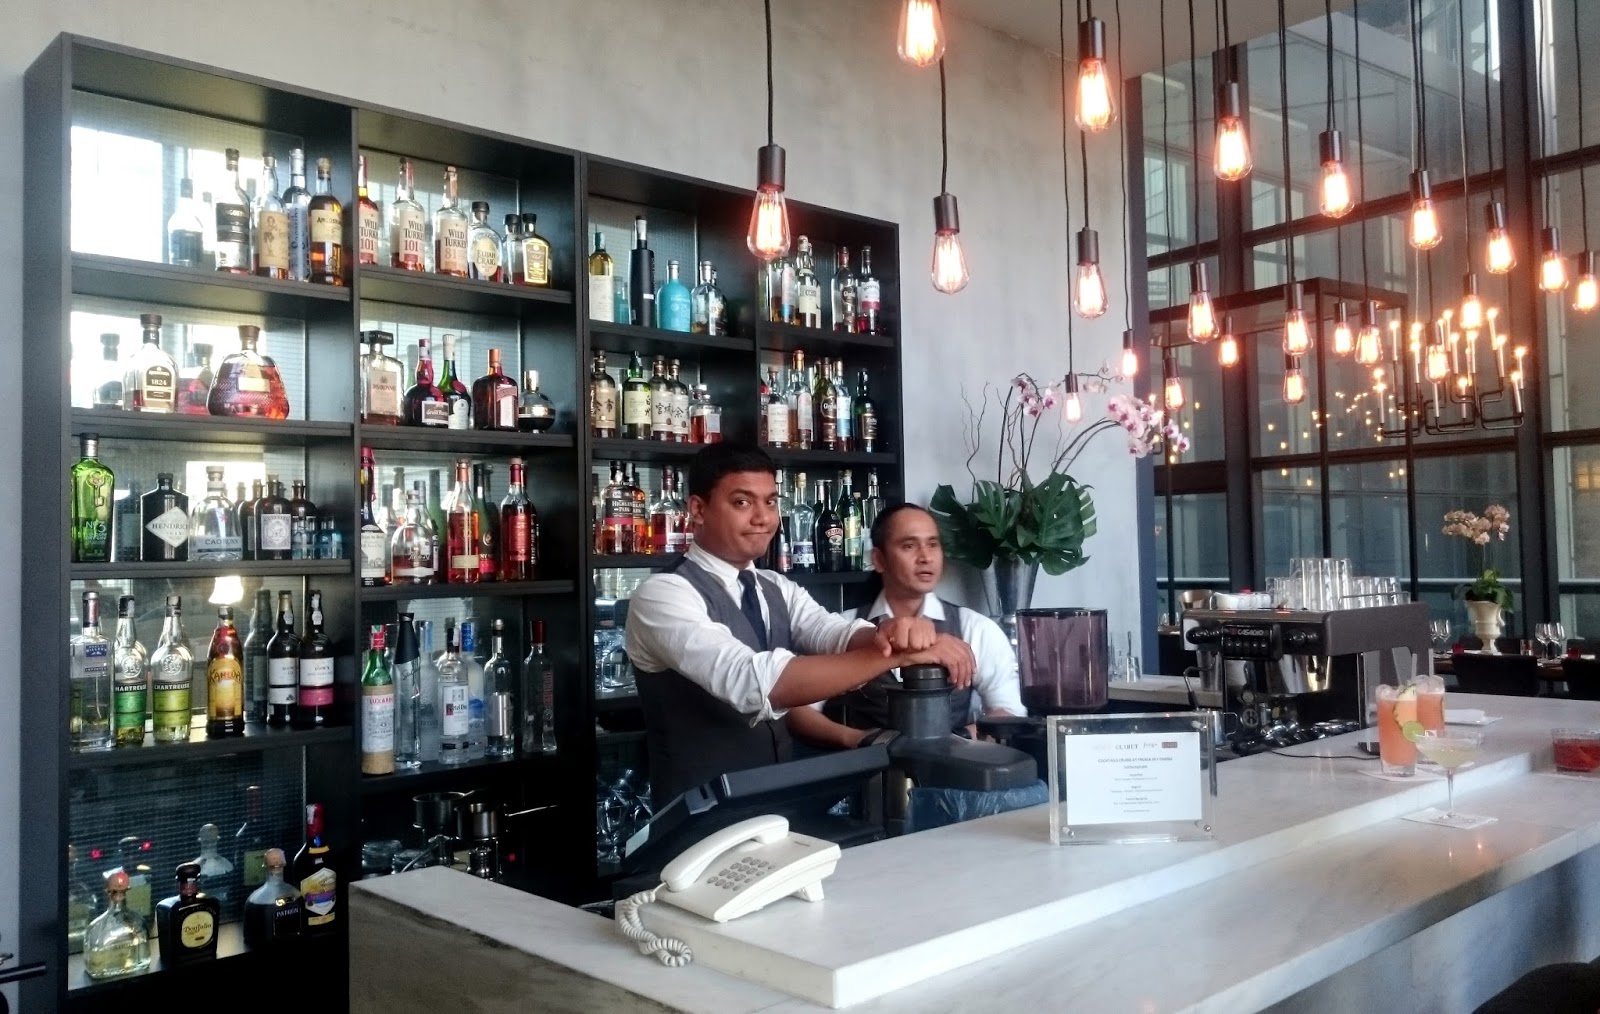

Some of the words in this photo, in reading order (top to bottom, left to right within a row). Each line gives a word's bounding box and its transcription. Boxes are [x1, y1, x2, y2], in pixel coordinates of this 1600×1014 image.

[448, 228, 465, 240] WILD
[360, 238, 374, 251] 101
[404, 239, 418, 252] 101
[476, 256, 496, 266] CRAIG
[151, 378, 167, 386] 1824
[97, 520, 107, 533] 3
[153, 682, 191, 692] CHARTREUSE
